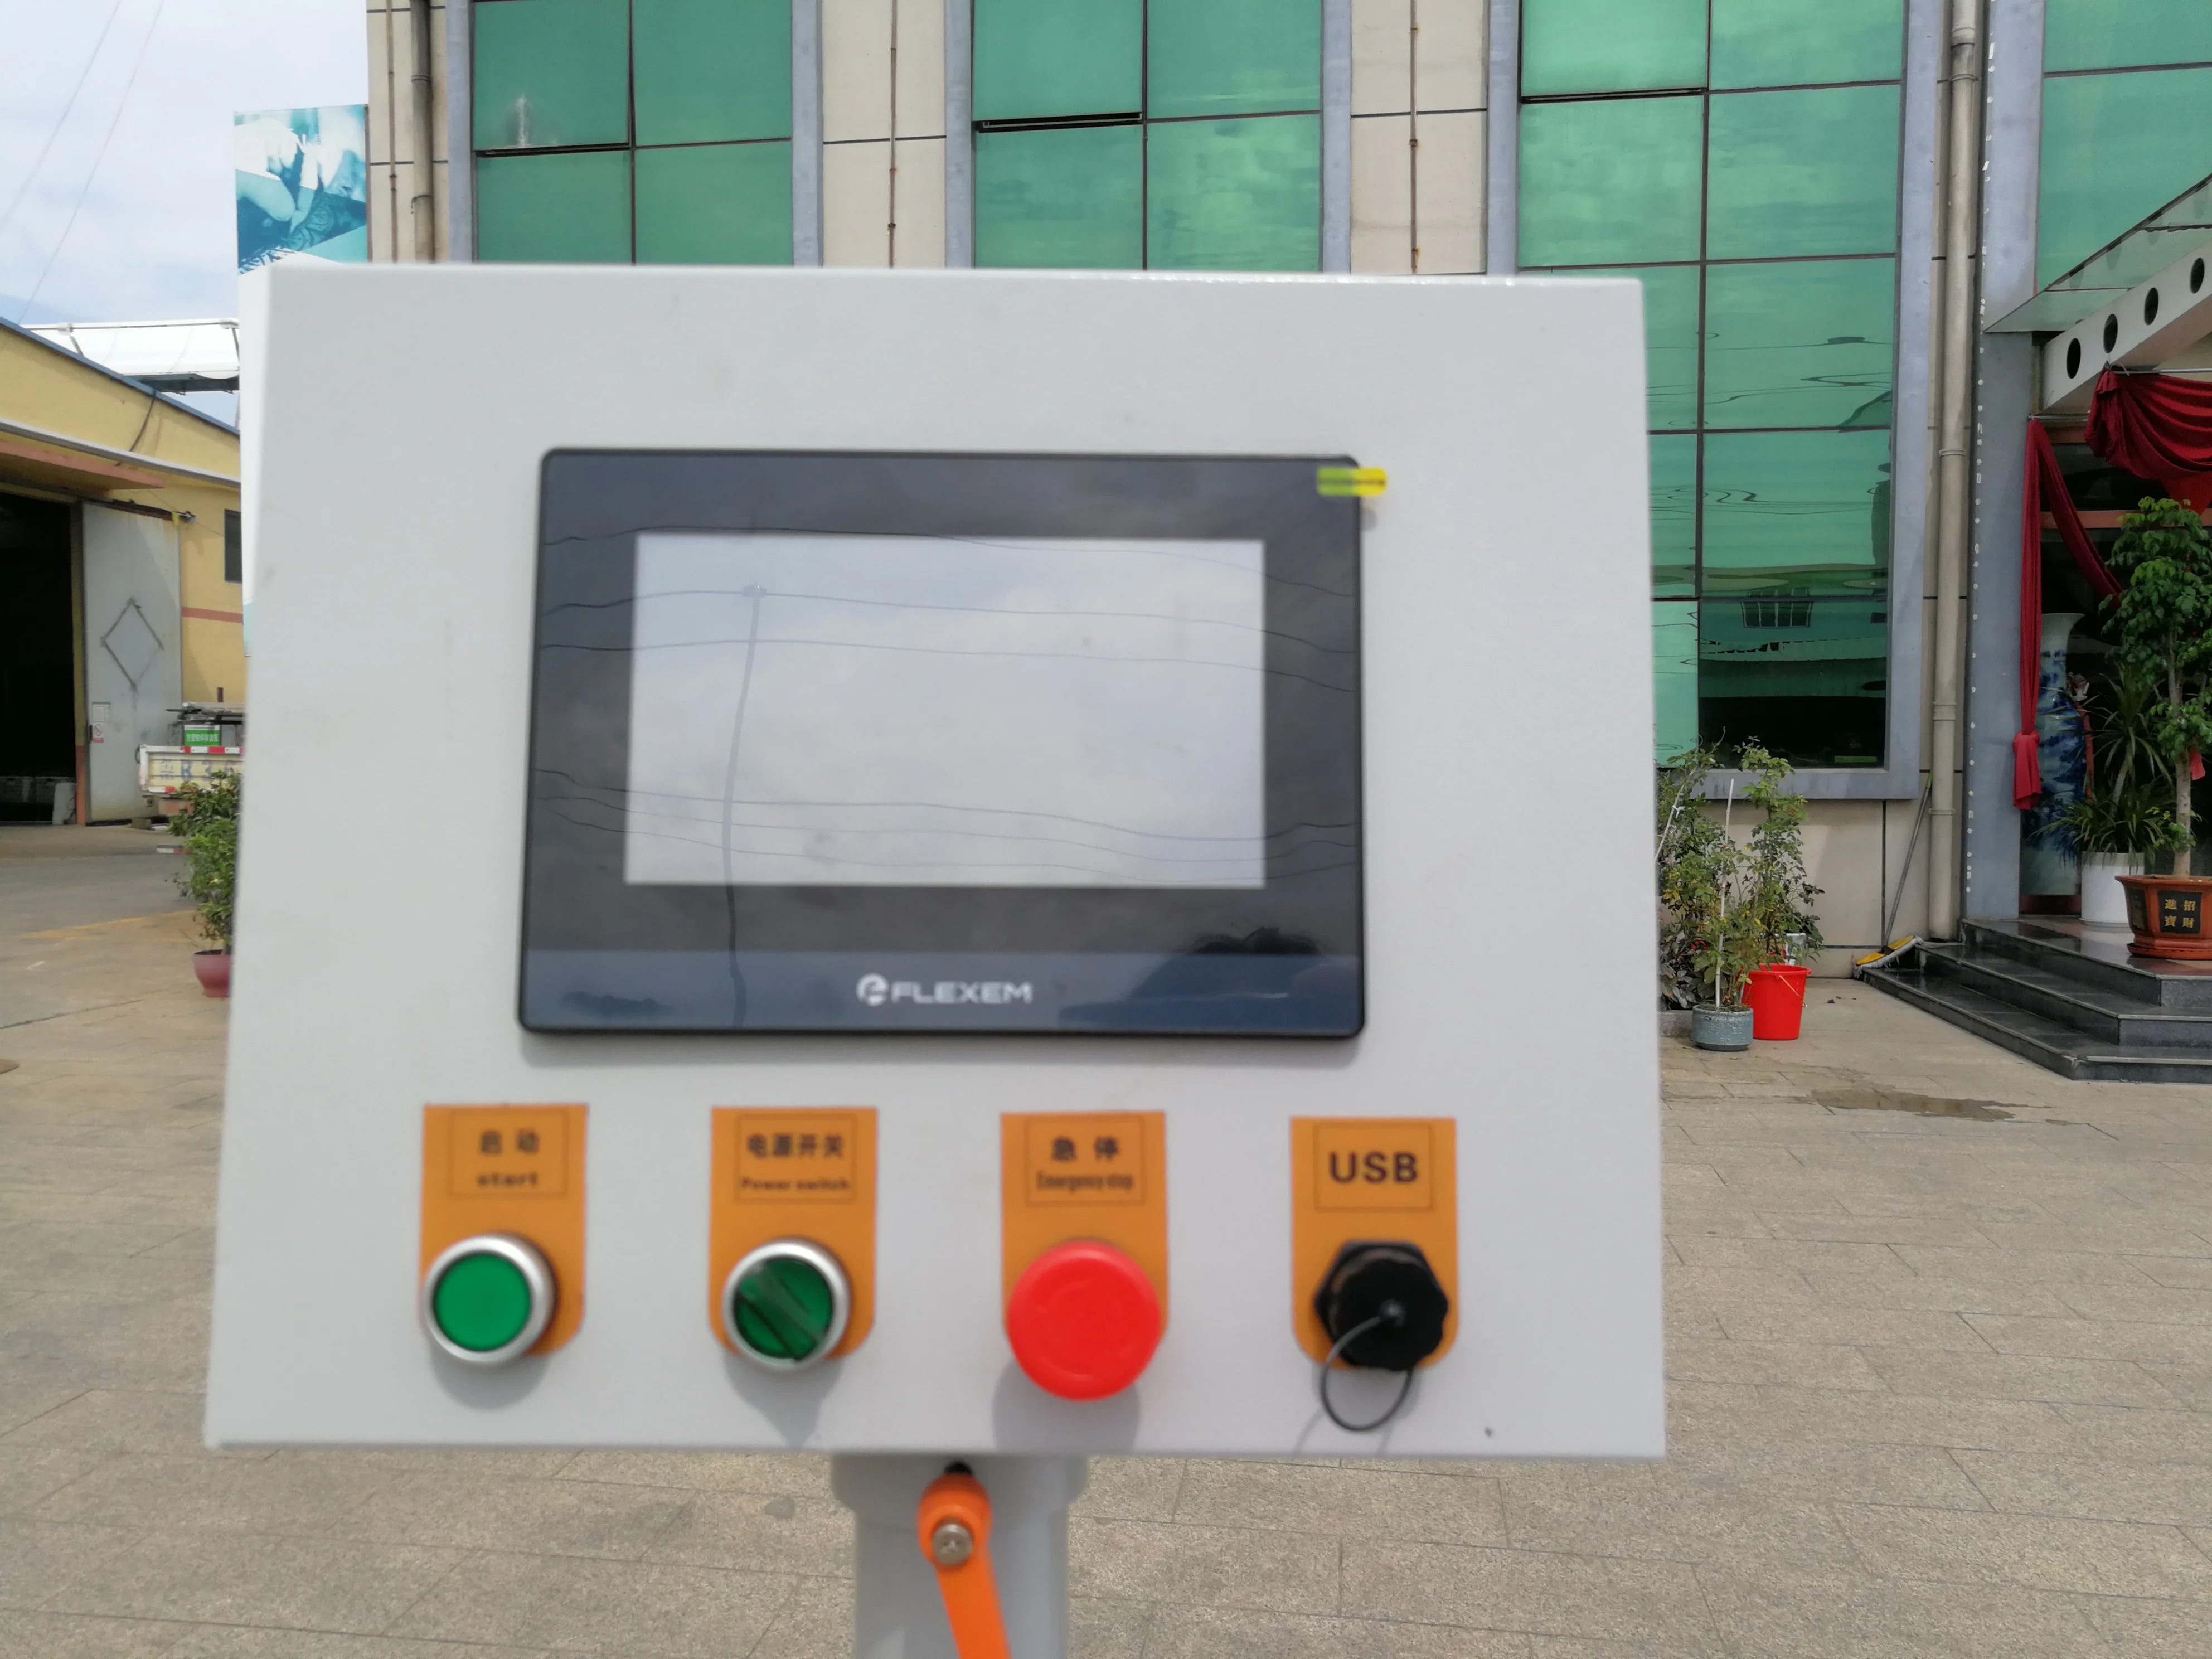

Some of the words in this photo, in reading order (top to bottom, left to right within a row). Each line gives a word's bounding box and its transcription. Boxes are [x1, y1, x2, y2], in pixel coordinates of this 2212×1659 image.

[891, 981, 1033, 1004] FLEXEM
[748, 1133, 844, 1158] 电源开关
[1328, 1151, 1418, 1185] USB
